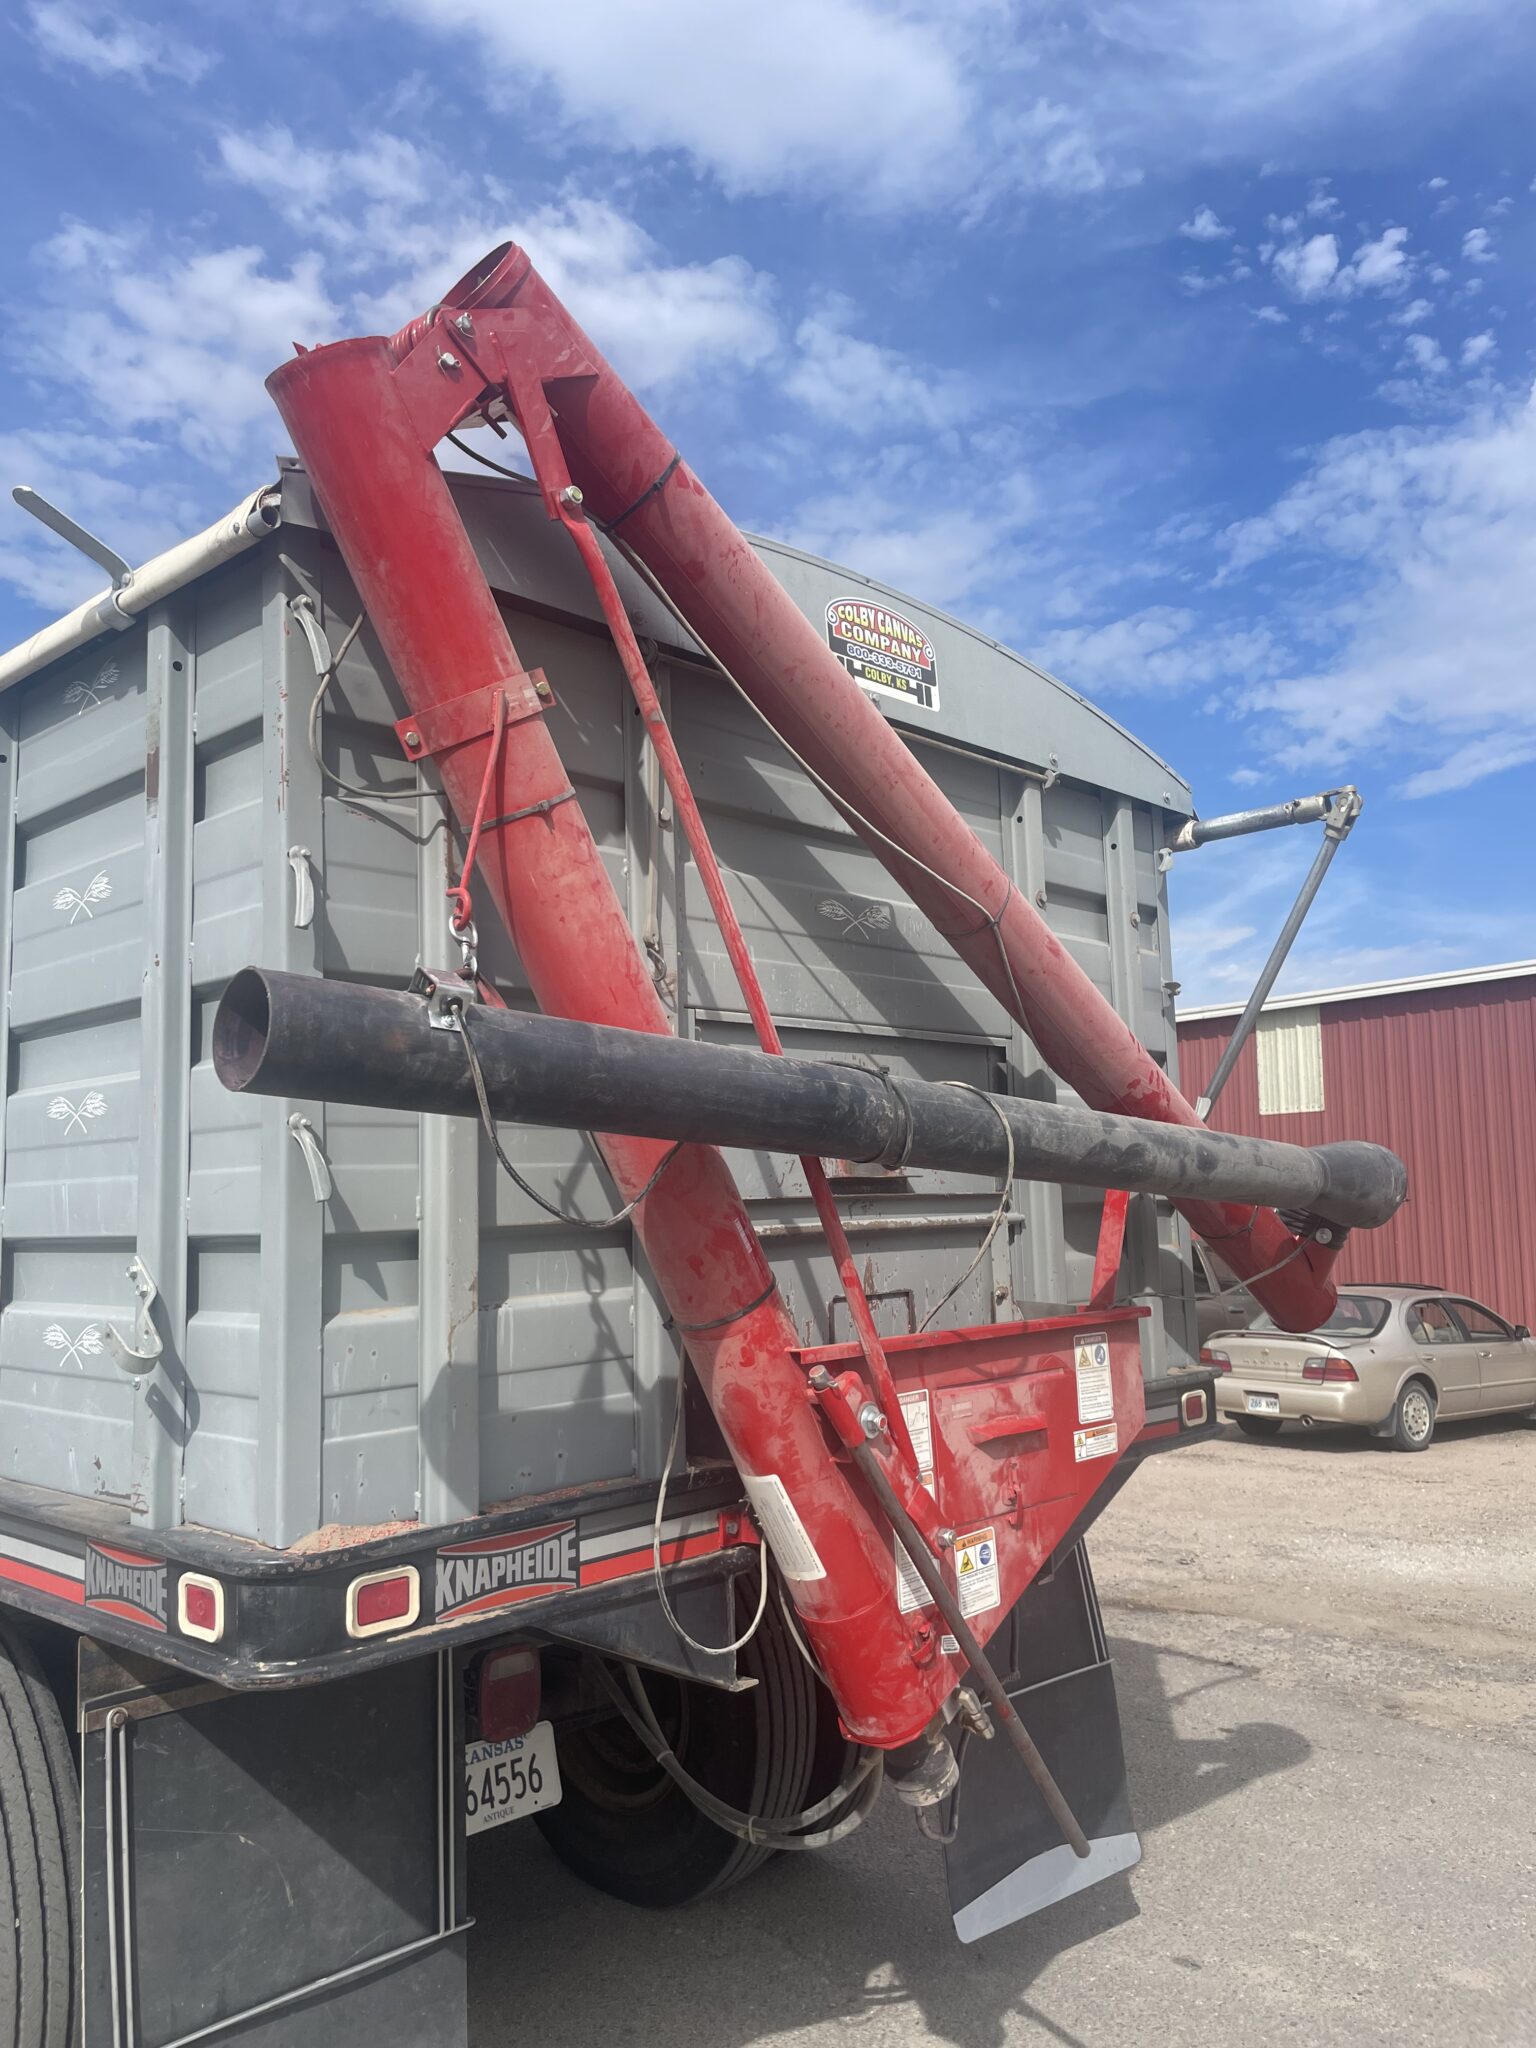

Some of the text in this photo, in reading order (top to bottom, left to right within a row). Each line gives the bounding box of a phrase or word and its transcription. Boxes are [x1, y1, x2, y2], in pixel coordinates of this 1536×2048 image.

[838, 605, 923, 648] COLBY CANVAS
[841, 621, 922, 663] COMPANY
[847, 643, 922, 679] 800-333-5791
[896, 676, 908, 690] KS
[86, 1546, 167, 1623] KNAPHEIDE
[435, 1529, 577, 1613] KNAPHEIDE
[465, 1753, 543, 1816] 64556
[483, 1806, 515, 1823] ANTIQUE
